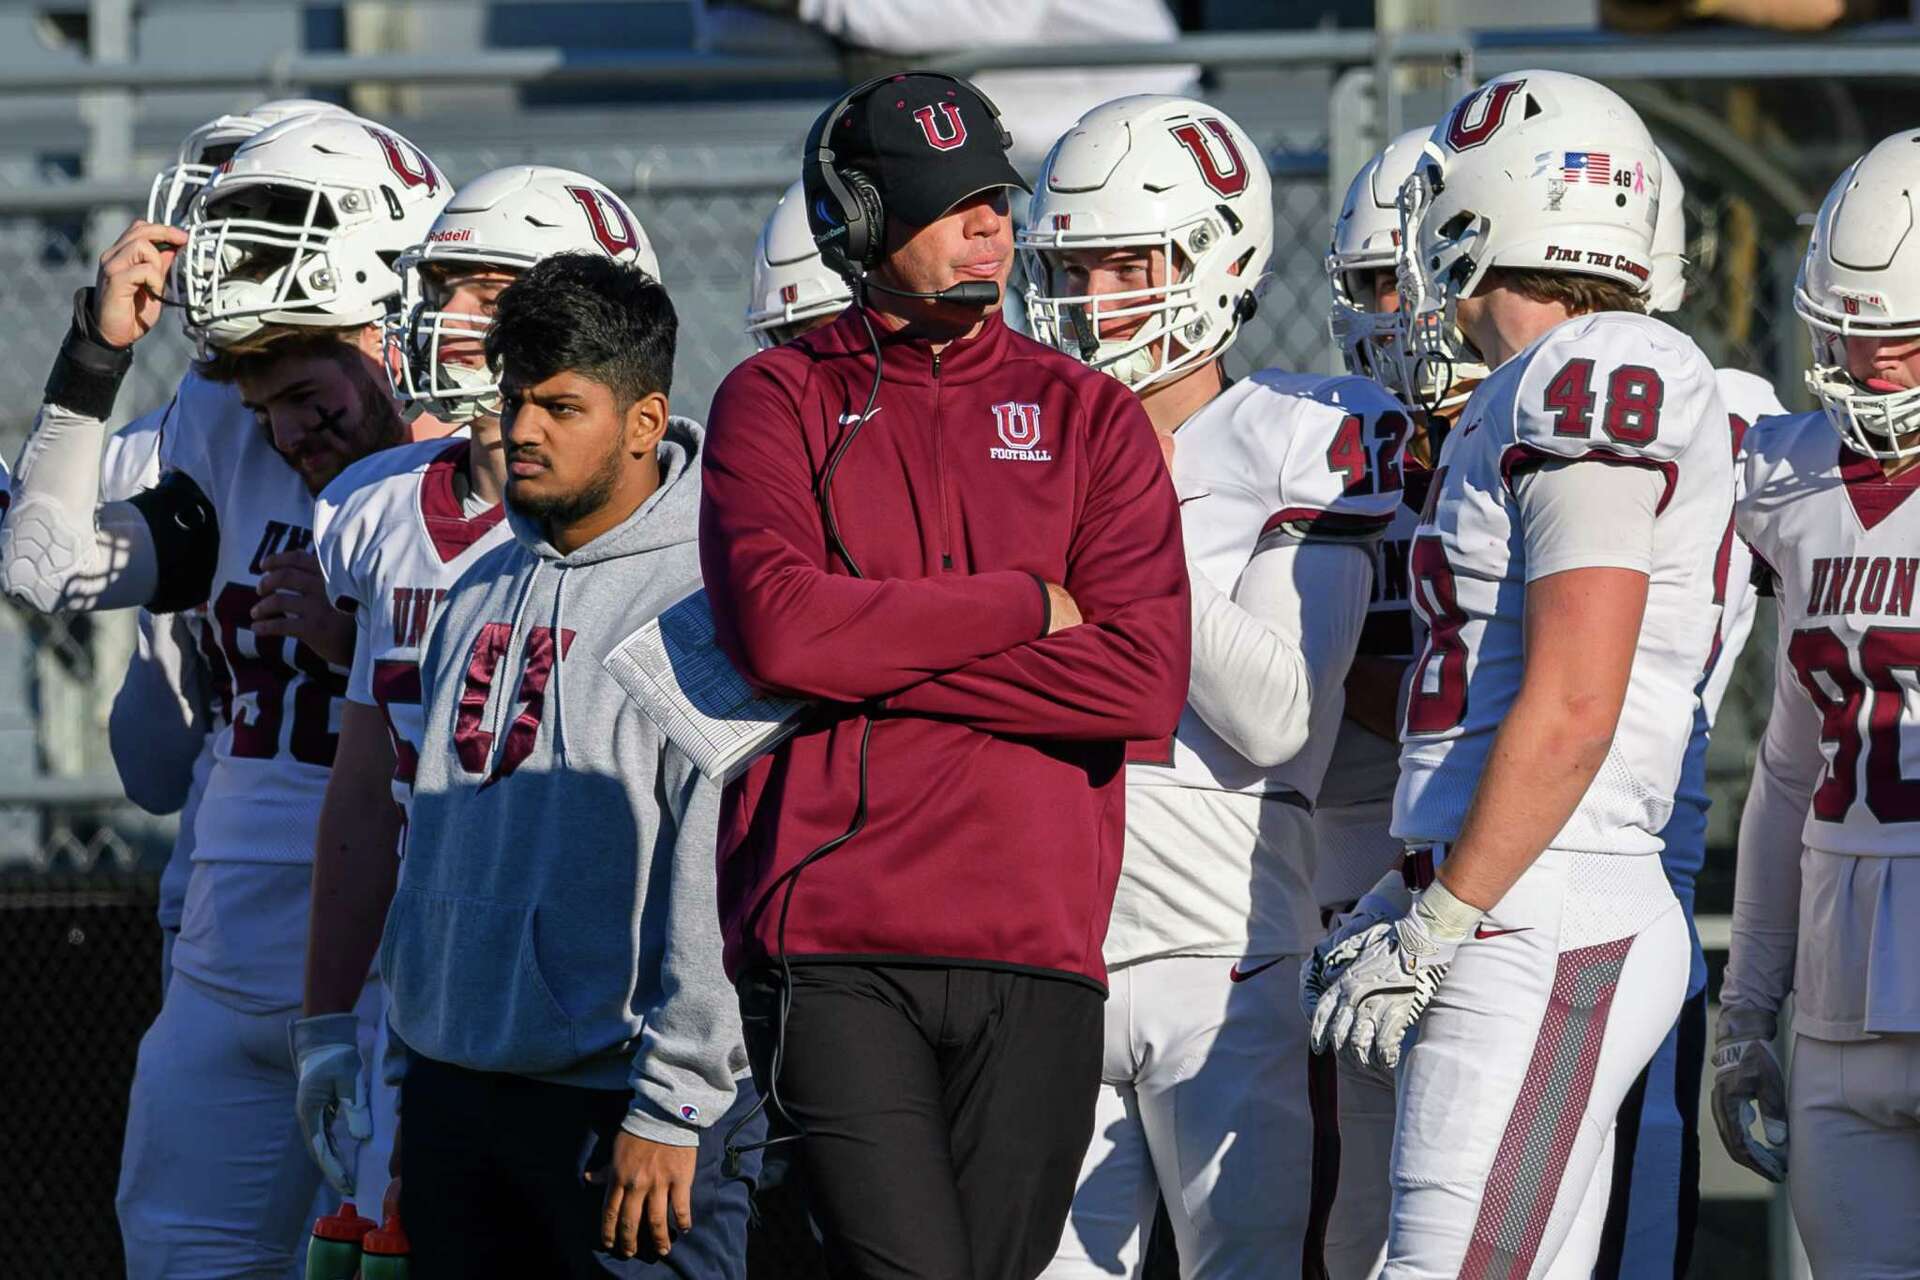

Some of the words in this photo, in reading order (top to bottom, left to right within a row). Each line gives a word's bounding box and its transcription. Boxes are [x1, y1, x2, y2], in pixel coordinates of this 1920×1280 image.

[912, 100, 968, 152] U
[1446, 78, 1528, 153] U
[362, 125, 441, 198] U
[1170, 117, 1251, 199] U
[1613, 169, 1632, 188] 48
[563, 185, 641, 264] U
[991, 401, 1041, 450] U
[1543, 357, 1665, 448] 48
[989, 447, 1052, 461] FOOTBALL
[1326, 410, 1408, 497] 42
[1806, 556, 1920, 617] UNION
